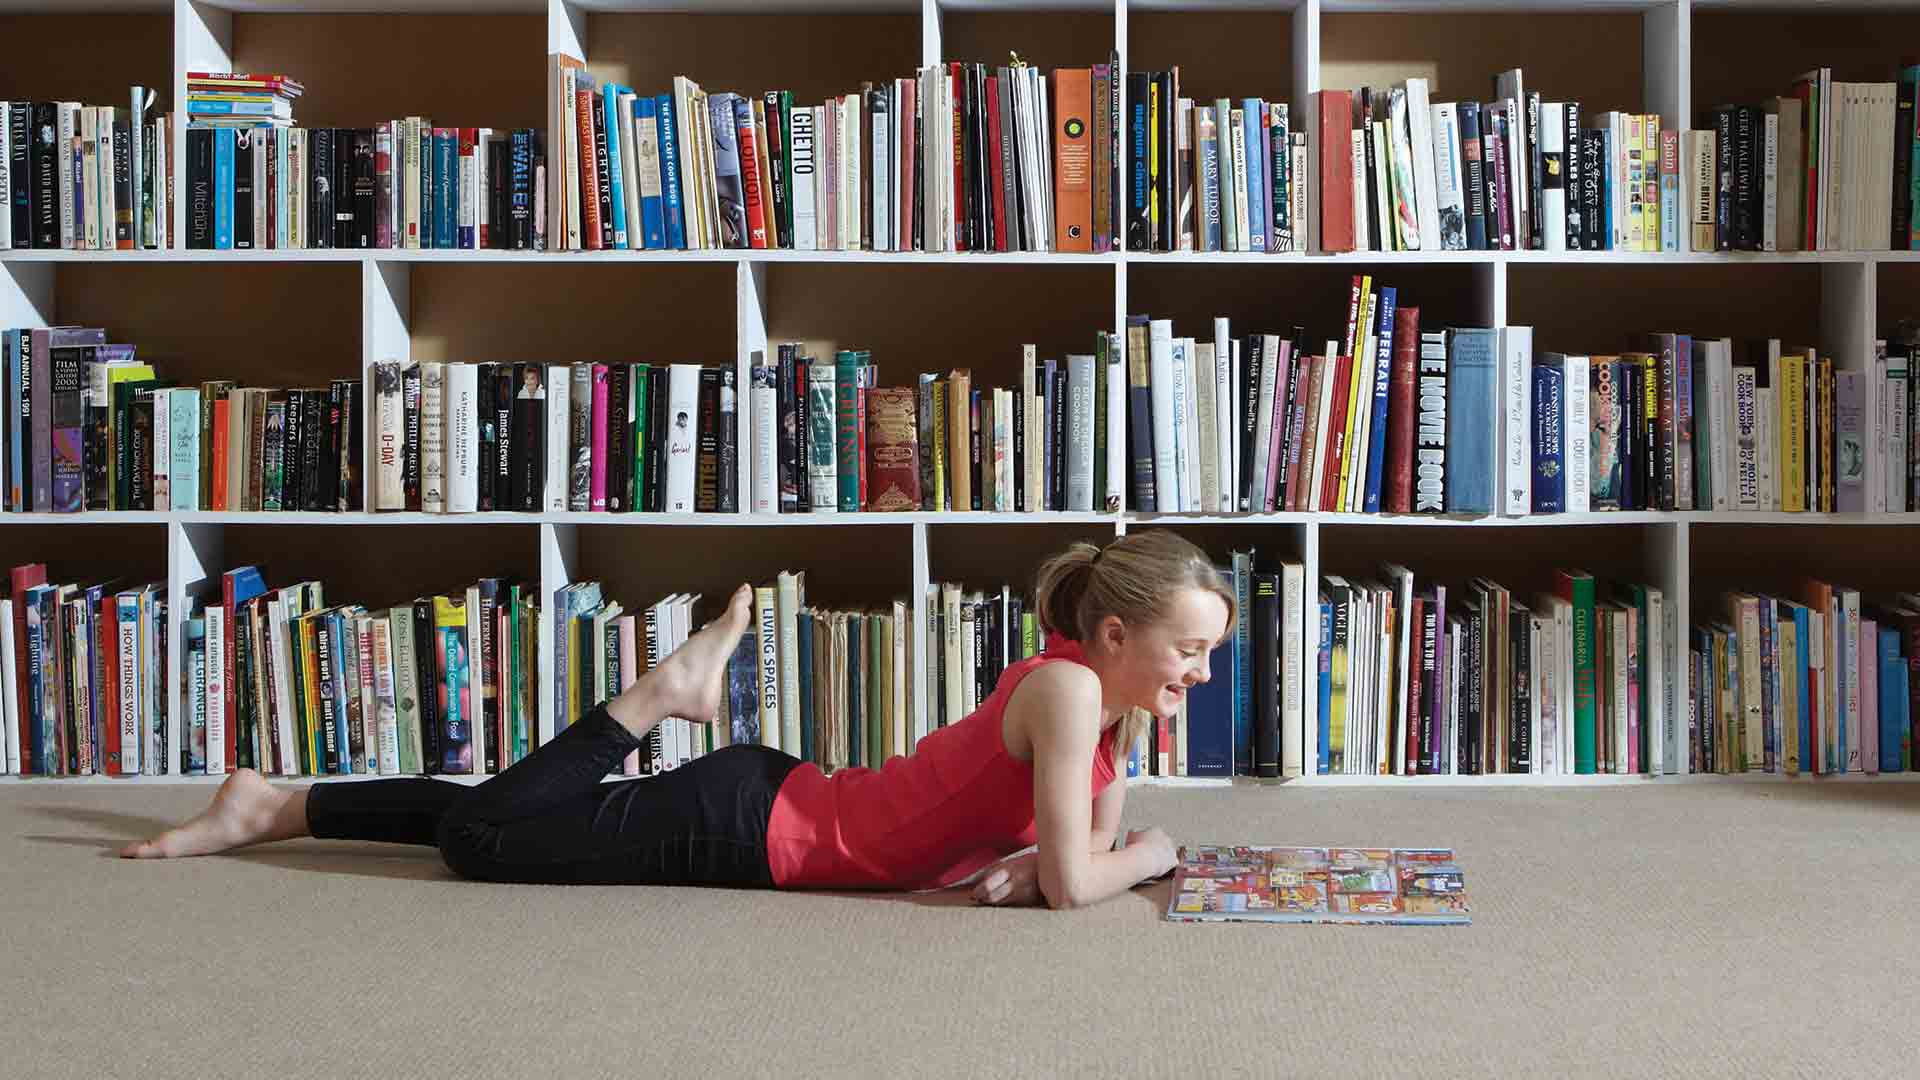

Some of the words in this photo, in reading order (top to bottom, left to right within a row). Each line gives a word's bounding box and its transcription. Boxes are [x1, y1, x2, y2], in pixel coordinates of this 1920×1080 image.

[62, 109, 70, 123] IAN
[579, 95, 590, 139] SOUTHEAST
[1133, 103, 1146, 158] magnum
[1569, 107, 1577, 140] REBEL
[1720, 114, 1730, 136] gene
[1739, 110, 1749, 136] GERI
[583, 144, 592, 168] ASIAN
[793, 112, 814, 175] GHETTO
[1584, 138, 1594, 157] MY
[1663, 136, 1677, 169] Spain
[1722, 137, 1732, 165] wilder
[596, 133, 609, 204] LIGHTING
[666, 161, 674, 181] COOK
[741, 135, 761, 207] London
[1207, 149, 1217, 181] MARY
[1570, 144, 1578, 179] MALES
[1739, 140, 1749, 201] HALLIWELL
[585, 174, 596, 224] SPECIALTIES
[668, 184, 676, 205] BOOK
[1135, 161, 1146, 208] cinema
[1584, 162, 1594, 205] STORY
[194, 181, 208, 240] Mitchum
[1209, 184, 1219, 224] TUDOR
[1700, 186, 1710, 221] BRITAIN
[1376, 330, 1392, 398] FERRARI
[1421, 330, 1446, 373] THE
[1176, 391, 1184, 401] to
[1646, 368, 1657, 419] WATCHMEN
[1663, 349, 1673, 411] CROATIA
[1745, 374, 1753, 398] NEW
[22, 398, 30, 417] 1991
[288, 395, 297, 440] sleepers
[1072, 386, 1081, 443] COOKBOOK
[1177, 403, 1185, 425] cook
[1419, 376, 1446, 446] MOVIE
[1551, 385, 1559, 435] CONSTANCE
[1738, 373, 1746, 429] COOKBOOK
[1746, 401, 1754, 428] YORK
[408, 415, 417, 449] PHILIP
[498, 409, 509, 437] James
[1664, 418, 1673, 432] AT
[381, 434, 394, 466] D-DAY
[499, 439, 509, 475] Stewart
[1664, 441, 1673, 480] TABLE
[1746, 450, 1754, 460] by
[1417, 449, 1445, 512] BOOK
[1739, 452, 1747, 499] O'NEILL
[1748, 463, 1756, 498] MOLLY
[398, 613, 408, 641] ROSE
[482, 598, 492, 653] HILLERMAN
[647, 609, 656, 628] THE
[763, 608, 775, 654] LIVING
[1337, 602, 1347, 640] VOGUE
[1425, 614, 1436, 627] TOO
[124, 628, 133, 655] HOW
[318, 630, 328, 658] thirsty
[448, 633, 457, 647] The
[606, 630, 617, 658] Nigel
[1025, 631, 1033, 649] veg
[1425, 649, 1435, 658] TO
[1576, 609, 1587, 665] CULINARIA
[30, 634, 41, 675] Lighting
[321, 661, 329, 680] work
[124, 656, 133, 699] THINGS
[447, 673, 458, 711] Companion
[608, 662, 618, 694] Slater
[764, 659, 776, 710] SPACES
[196, 668, 205, 728] GRANGER
[324, 700, 333, 720] matt
[125, 702, 134, 735] WORK
[450, 722, 459, 739] Food
[325, 721, 335, 752] skinner
